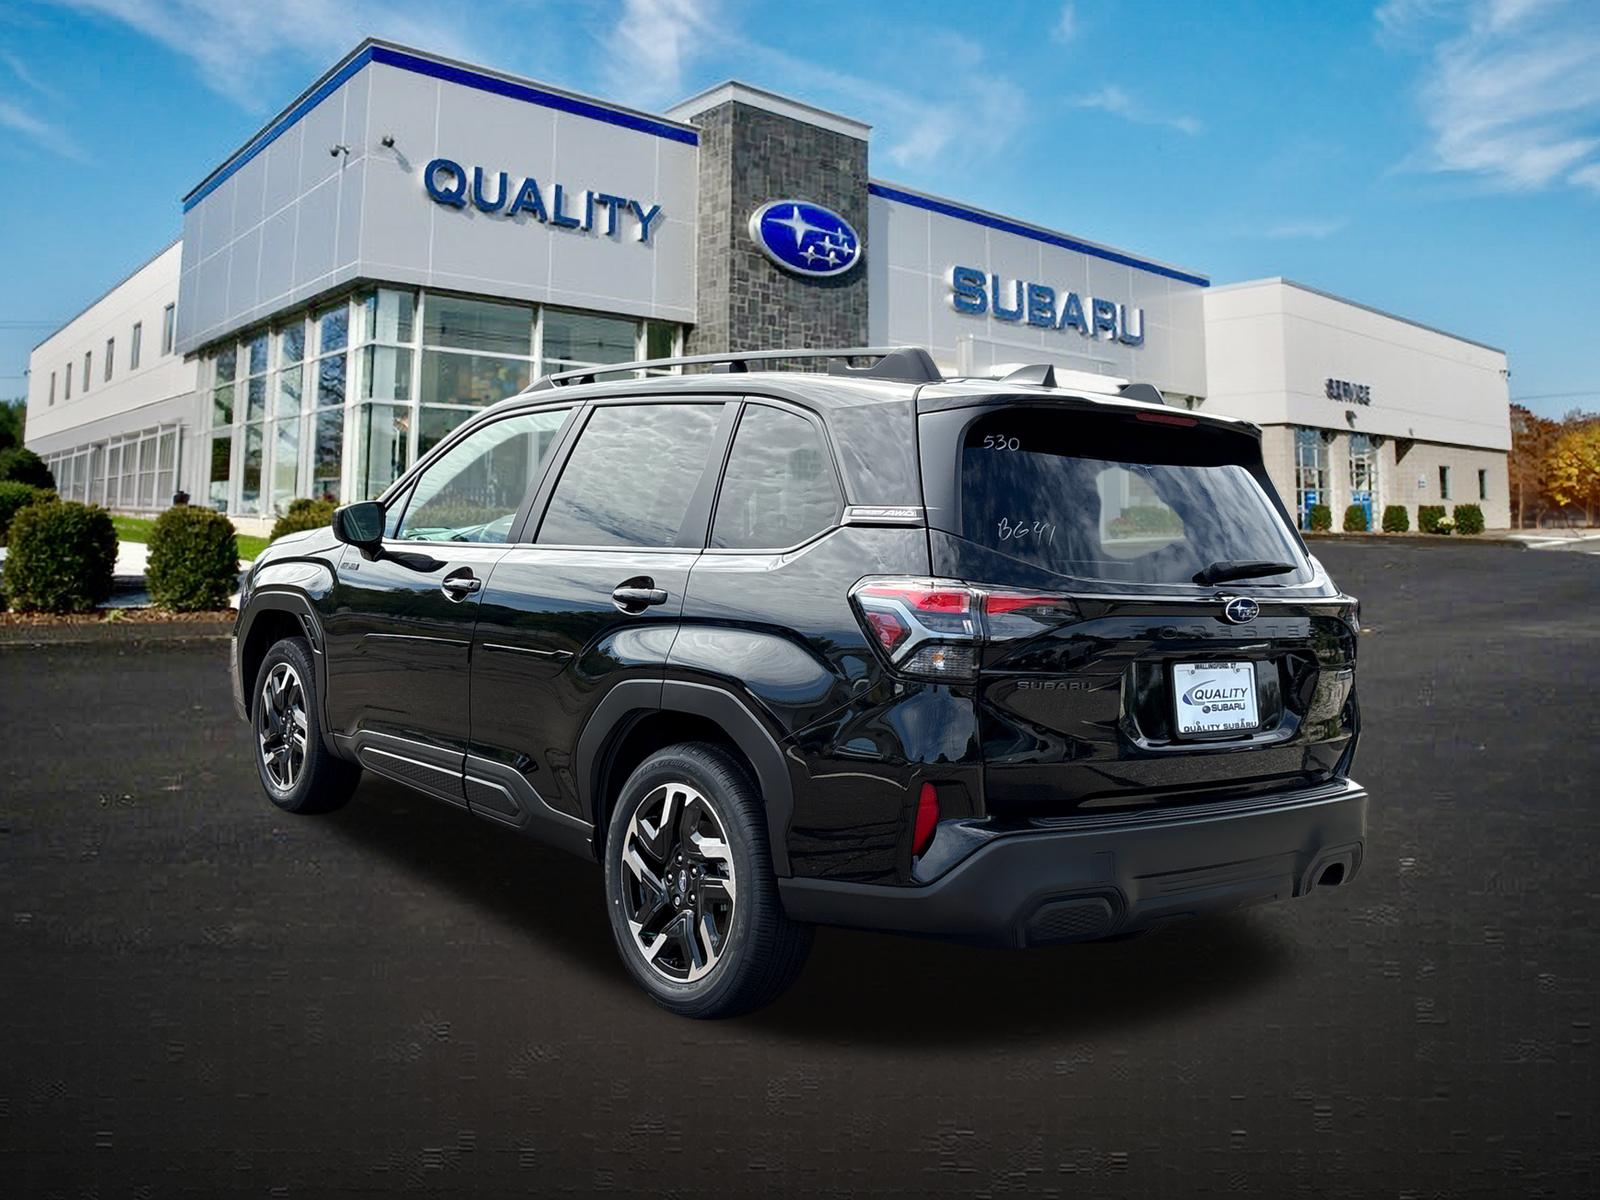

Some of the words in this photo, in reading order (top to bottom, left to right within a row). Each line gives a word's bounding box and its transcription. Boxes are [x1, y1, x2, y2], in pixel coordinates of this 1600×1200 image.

[423, 158, 662, 243] QUALITY
[949, 265, 1145, 347] SUBARU
[983, 434, 1020, 451] 530
[1017, 681, 1092, 690] SUBARU
[1194, 688, 1248, 700] QUALITY
[1211, 703, 1246, 712] SUBARU
[1183, 723, 1220, 732] QUALITY
[1223, 721, 1257, 730] SUBARU
